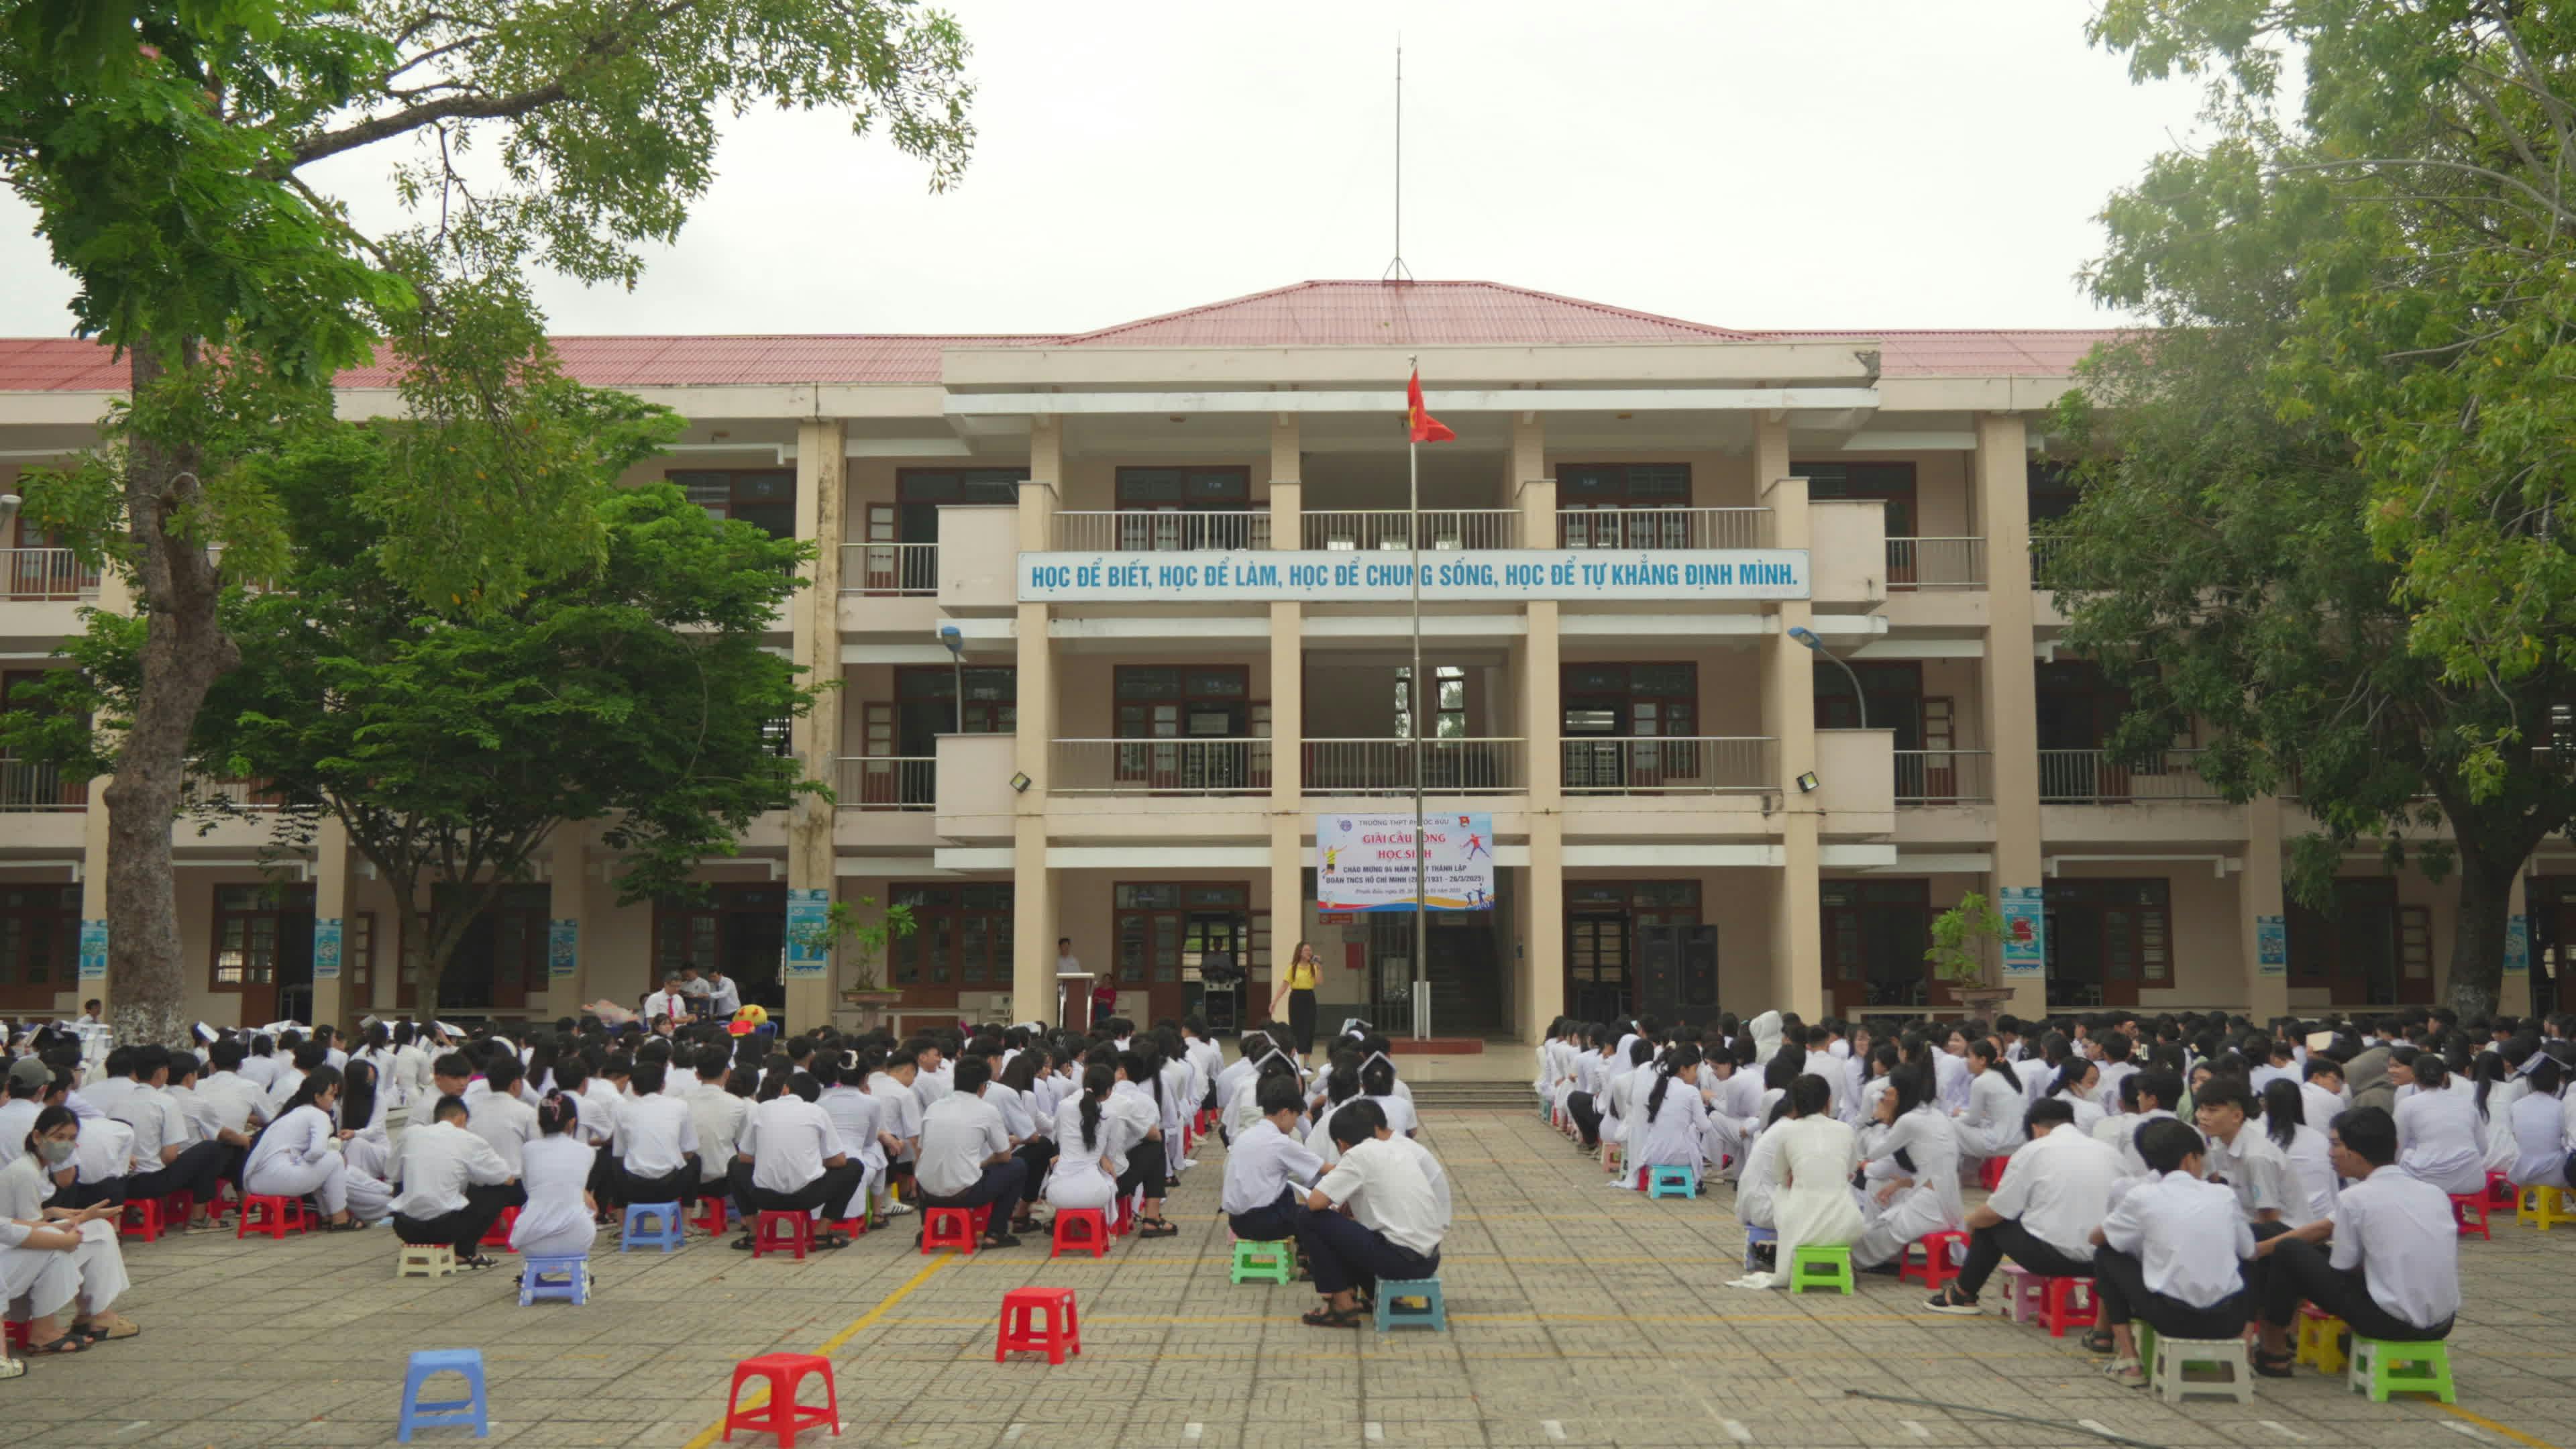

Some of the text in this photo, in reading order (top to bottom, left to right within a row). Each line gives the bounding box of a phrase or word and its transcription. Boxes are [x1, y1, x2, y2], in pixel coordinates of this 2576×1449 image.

[1031, 566, 1071, 593] HỌC
[1077, 557, 1102, 587] ĐỂ
[1108, 558, 1152, 590] BIẾT,
[1159, 565, 1199, 592] HỌC
[1203, 556, 1230, 587] ĐỂ
[1235, 560, 1283, 588] LÀM,
[1289, 565, 1329, 591] HỌC
[1335, 555, 1361, 586] ĐỂ
[1439, 556, 1499, 588] SỐNG,
[1505, 564, 1545, 591] HỌC
[1550, 555, 1576, 586] ĐỂ
[1581, 561, 1608, 591] TỰ
[1684, 564, 1733, 590] ĐỊNH
[1739, 559, 1798, 585] MÌNH.
[1417, 831, 1446, 843] ÔNG
[1378, 849, 1432, 862] HỌC SIH
[1411, 864, 1429, 872] NY
[1389, 875, 1407, 883] MINH
